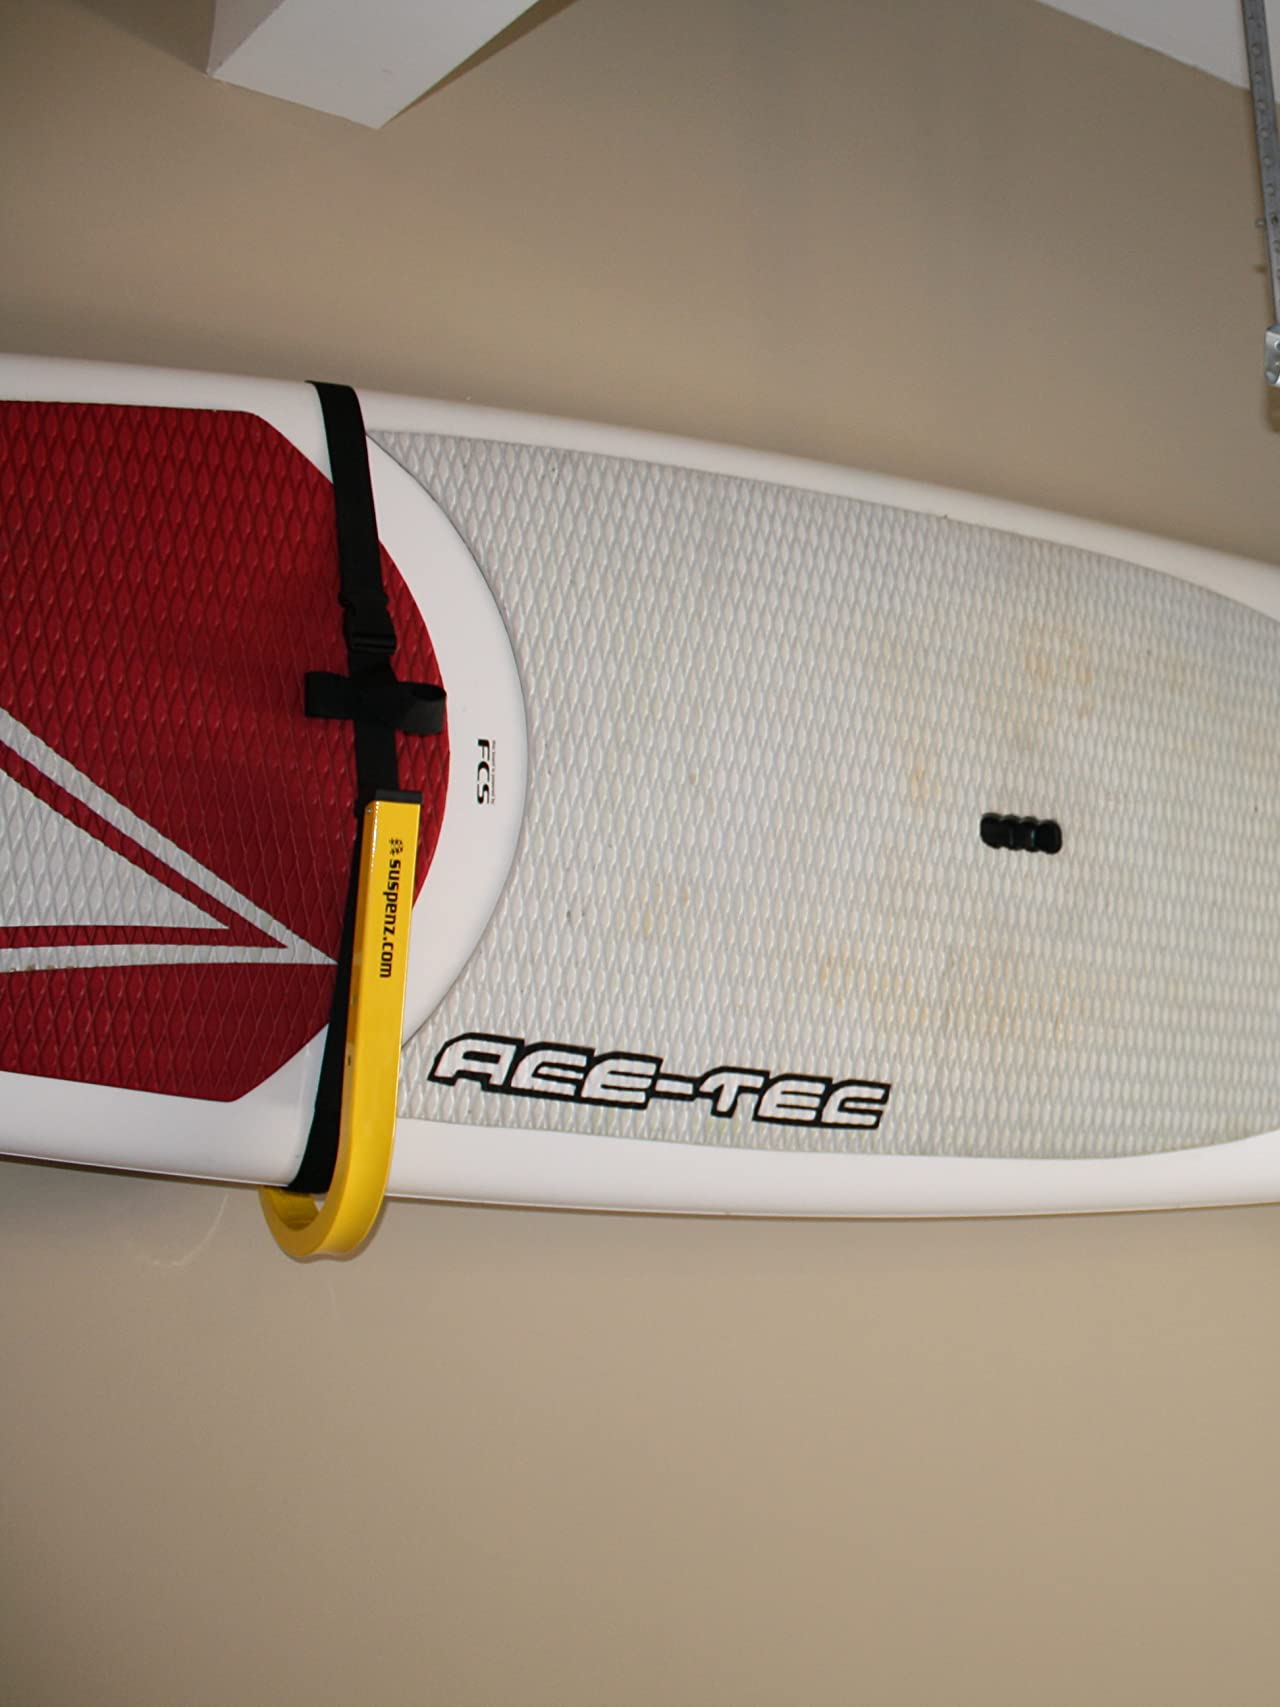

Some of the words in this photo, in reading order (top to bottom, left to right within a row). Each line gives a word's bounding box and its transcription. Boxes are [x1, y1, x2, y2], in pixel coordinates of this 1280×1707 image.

[477, 738, 490, 805] FCS
[380, 859, 402, 978] suspenz.com
[427, 1032, 892, 1130] ACE-TEC
